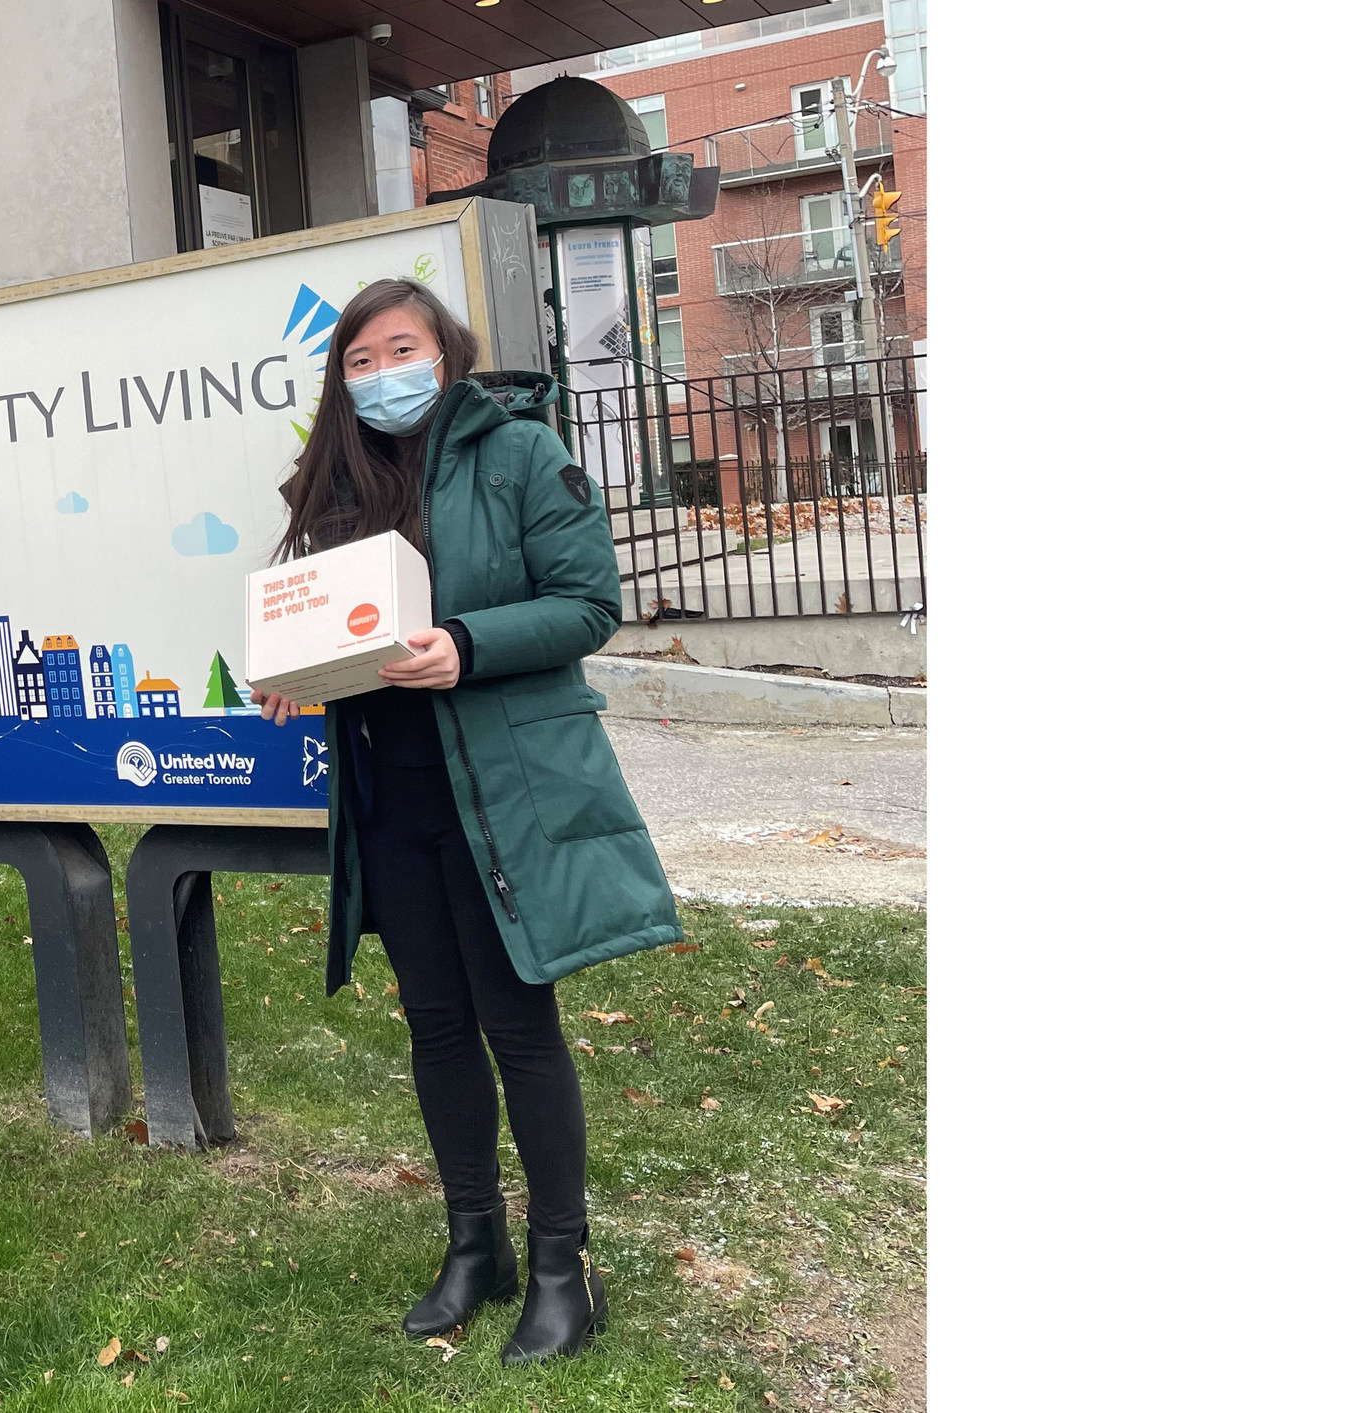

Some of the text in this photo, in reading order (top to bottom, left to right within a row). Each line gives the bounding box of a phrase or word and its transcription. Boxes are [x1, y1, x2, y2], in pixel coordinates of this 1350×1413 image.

[568, 240, 619, 251] Learn French
[81, 354, 297, 434] LIVING
[263, 570, 318, 594] THIS BOX IS
[263, 586, 310, 609] HAPPY TO
[285, 601, 305, 616] YOU
[159, 753, 256, 774] United Way
[162, 773, 252, 785] Greater Toronto
